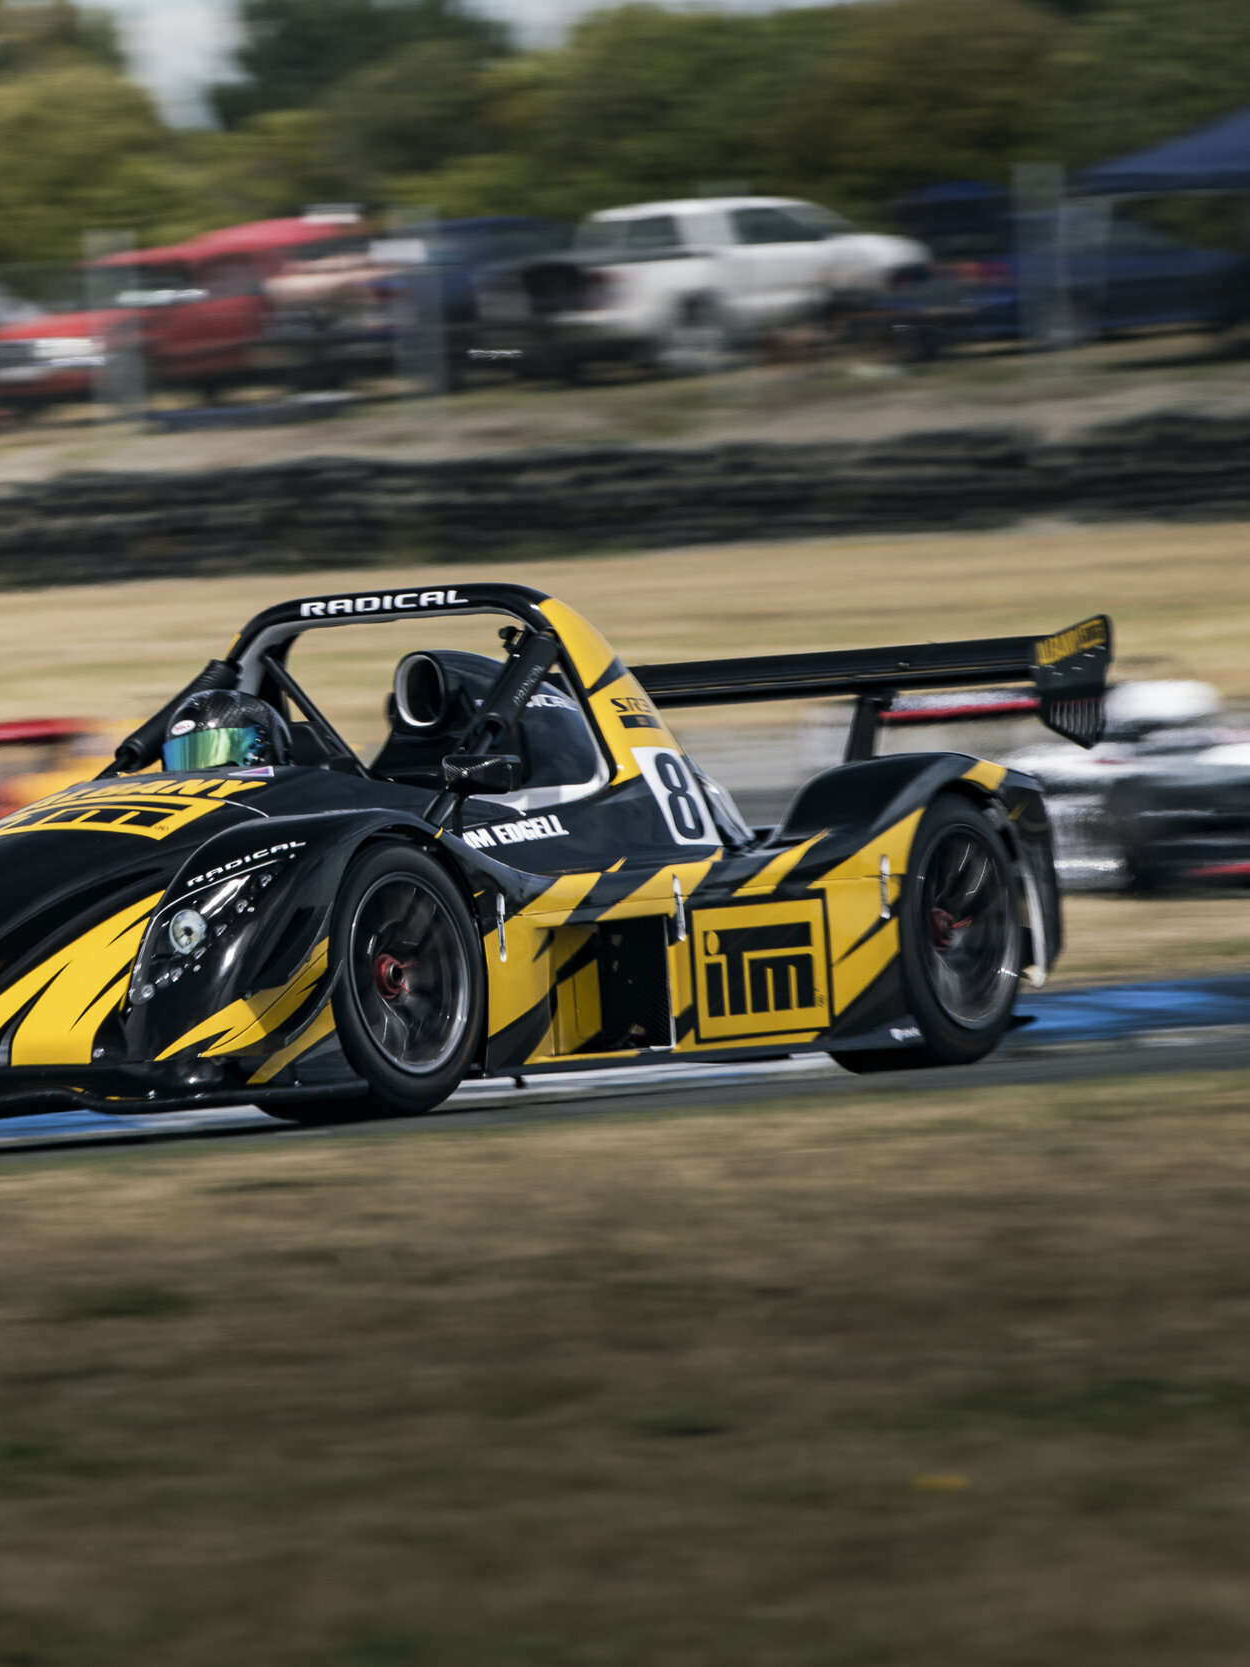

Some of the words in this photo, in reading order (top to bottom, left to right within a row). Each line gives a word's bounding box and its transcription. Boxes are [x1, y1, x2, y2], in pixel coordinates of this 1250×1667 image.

[300, 590, 470, 617] RADICAL
[655, 753, 705, 840] 8
[462, 828, 498, 849] IM
[491, 814, 570, 844] EDGELL
[187, 841, 306, 887] RADICAL
